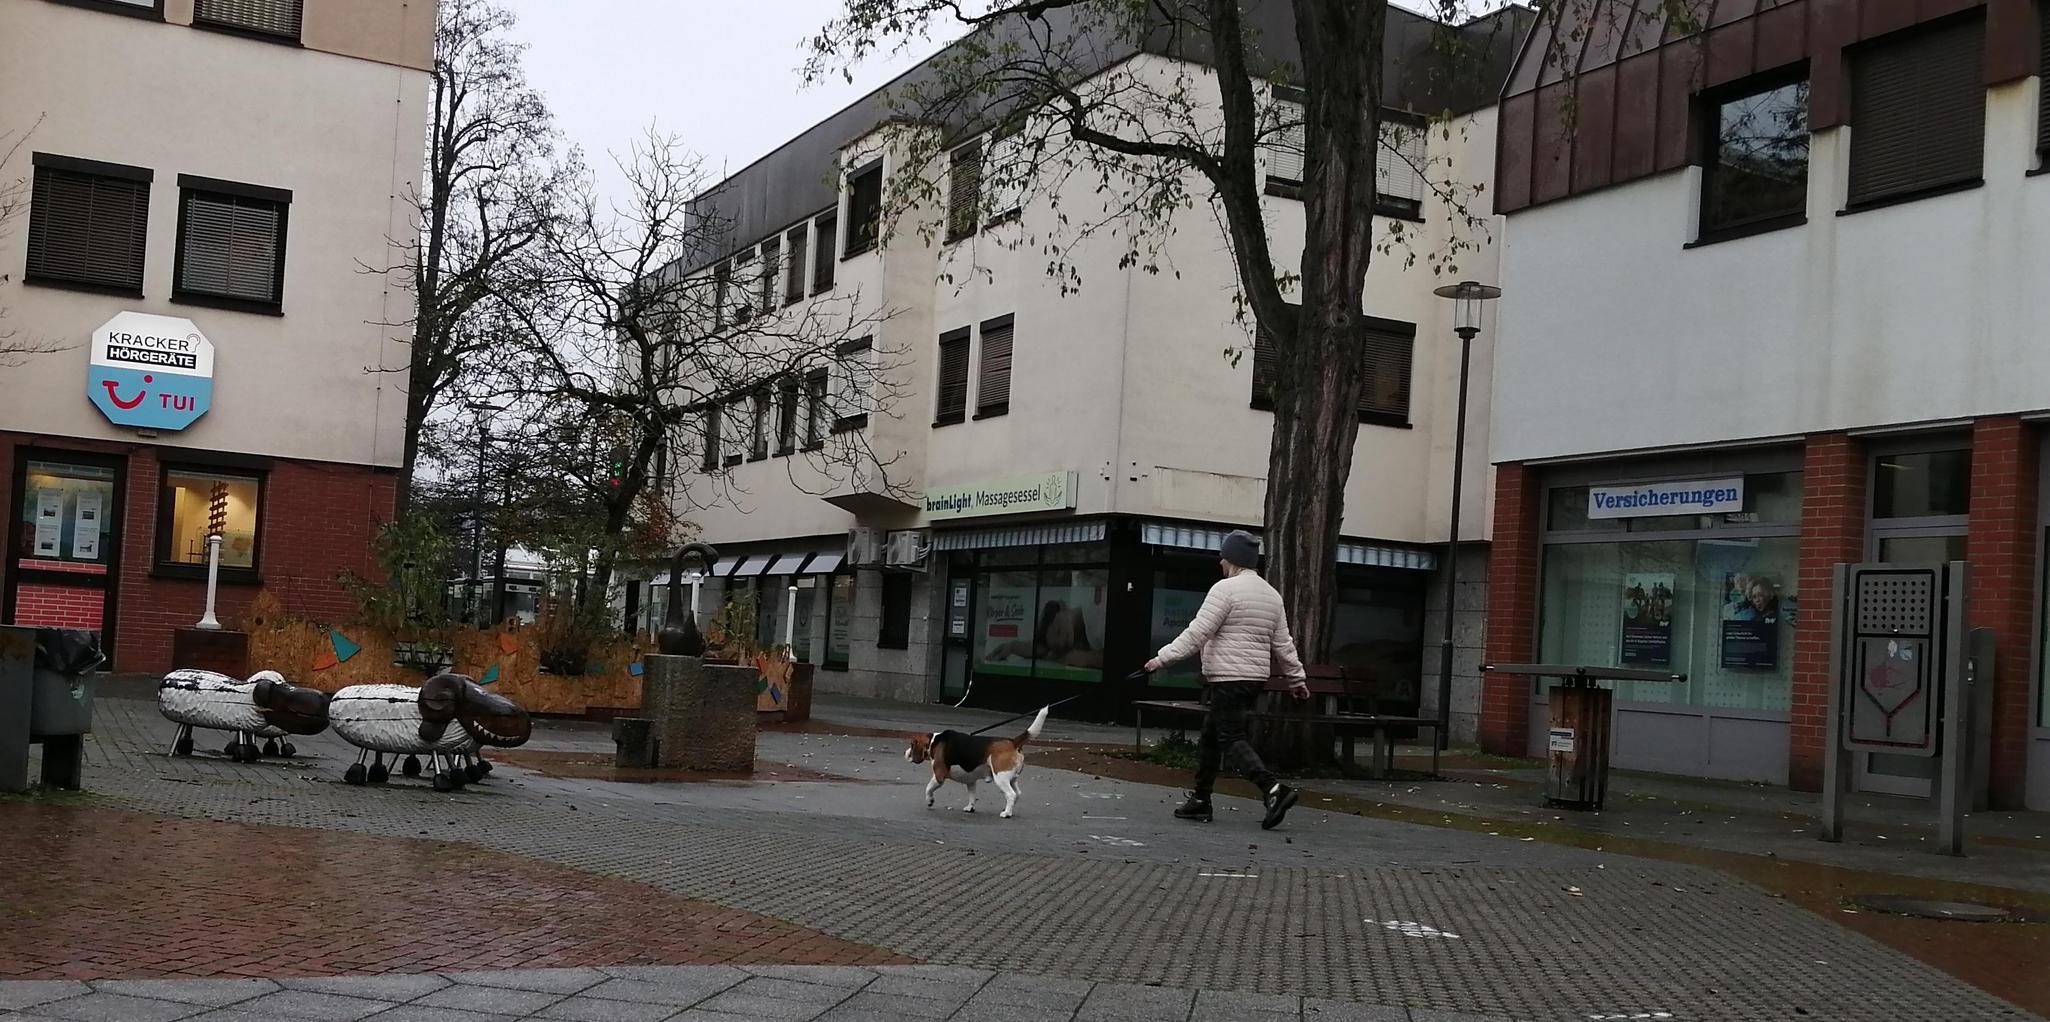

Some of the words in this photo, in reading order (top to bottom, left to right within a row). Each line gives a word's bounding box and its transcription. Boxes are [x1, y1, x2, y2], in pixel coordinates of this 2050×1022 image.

[109, 332, 189, 351] KRACKER
[109, 347, 194, 367] HÖRGERÄTE
[159, 394, 195, 411] TUI
[975, 484, 1041, 508] Massagesessel
[1593, 488, 1738, 508] Versicherungen
